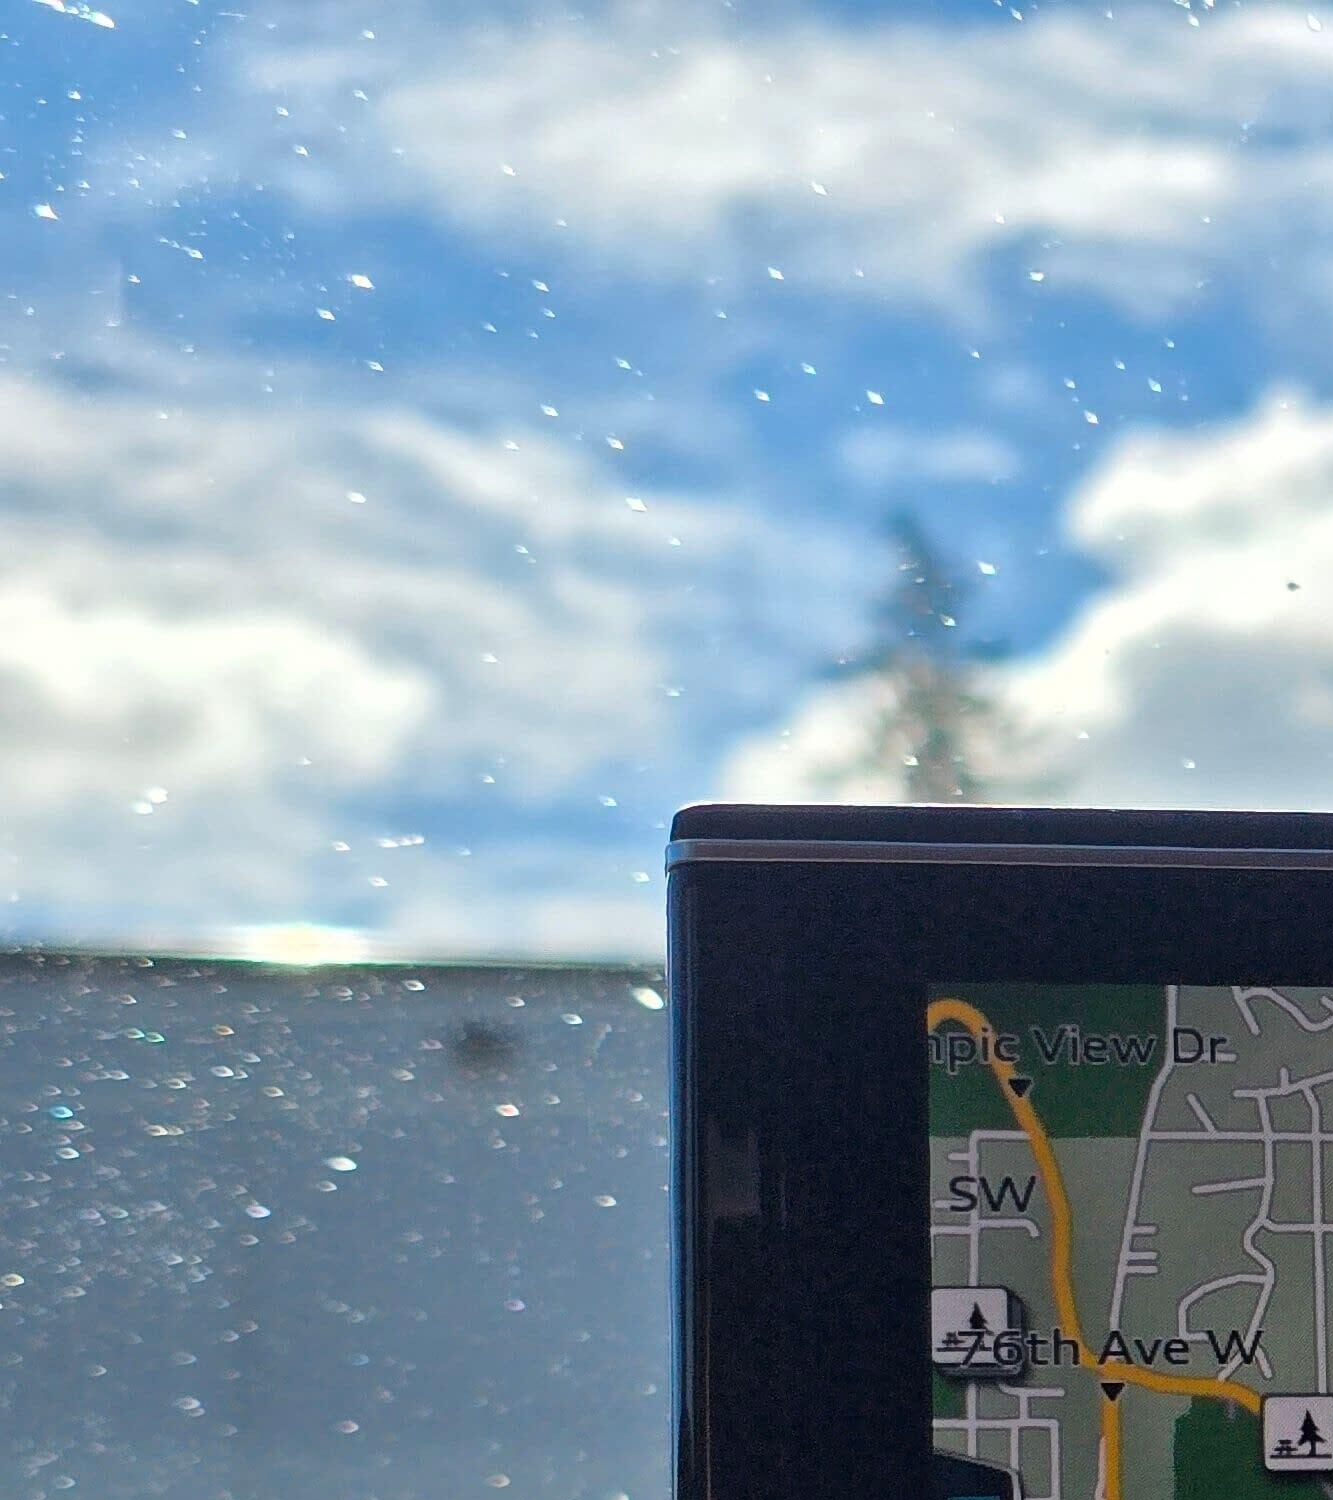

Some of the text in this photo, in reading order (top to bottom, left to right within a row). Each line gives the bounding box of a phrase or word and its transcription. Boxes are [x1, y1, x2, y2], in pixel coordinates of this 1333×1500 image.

[1032, 1027, 1156, 1063] View
[1173, 1028, 1227, 1063] Dr
[949, 1175, 1036, 1212] SW
[956, 1329, 1264, 1367] 76th Ave W
